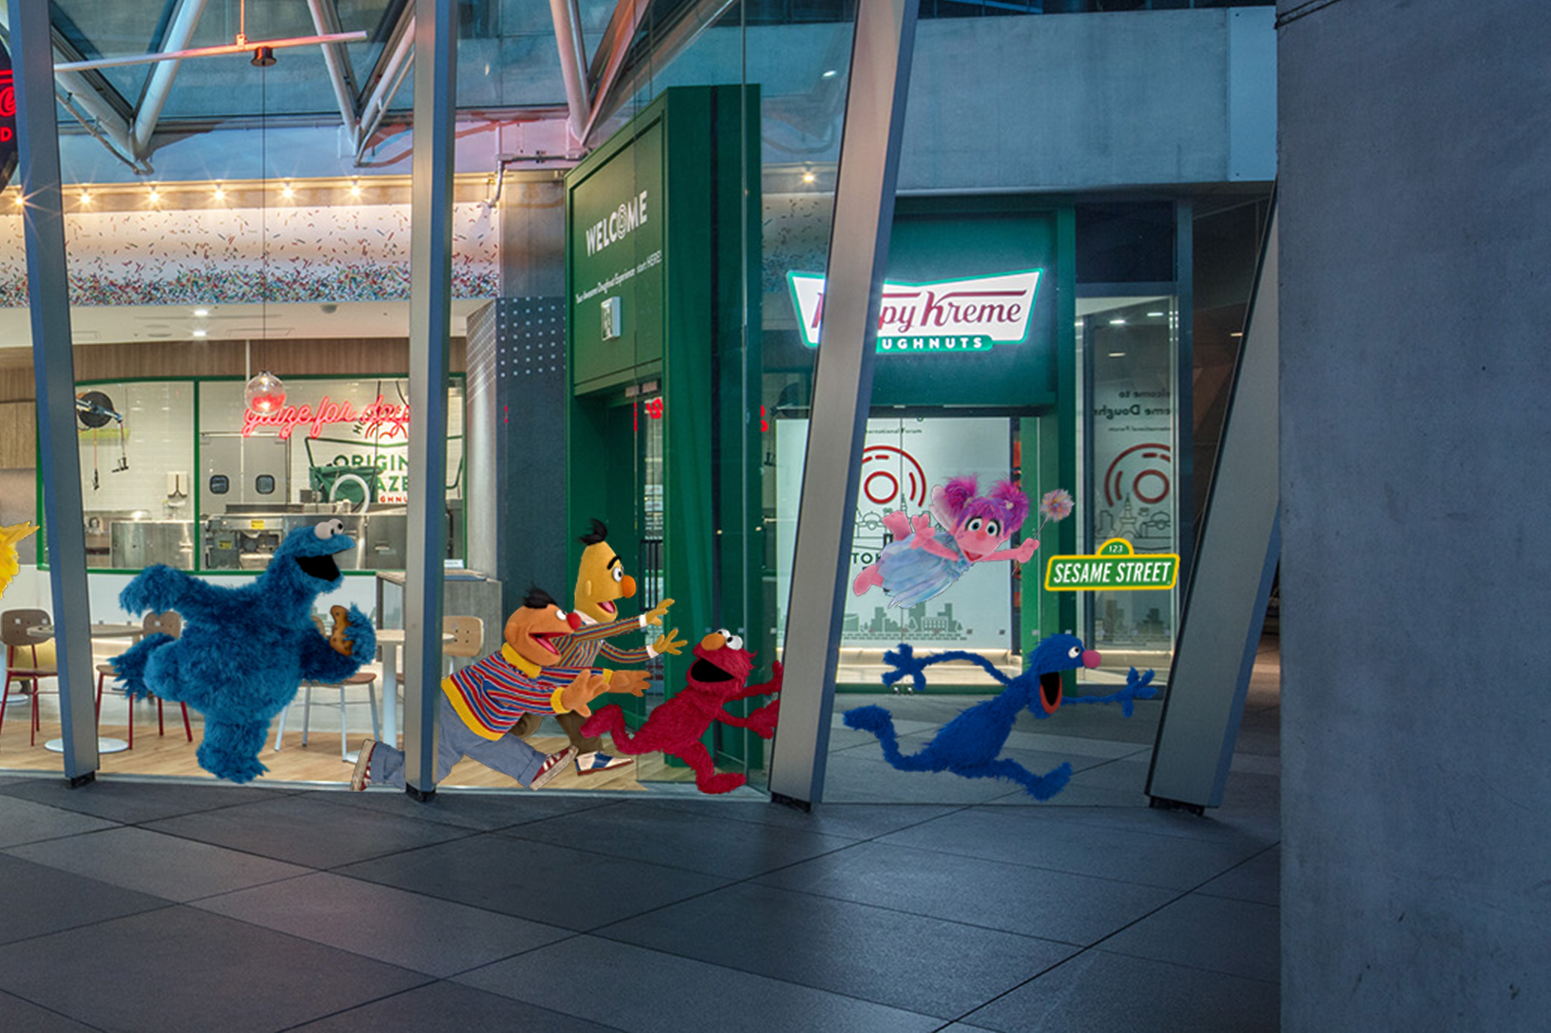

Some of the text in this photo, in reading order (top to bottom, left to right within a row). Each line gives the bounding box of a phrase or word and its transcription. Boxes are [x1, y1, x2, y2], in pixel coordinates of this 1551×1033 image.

[585, 190, 648, 257] WELCOME
[920, 290, 1026, 327] Kreme
[881, 337, 983, 350] UGHNUTS
[333, 454, 408, 471] ORIGIN
